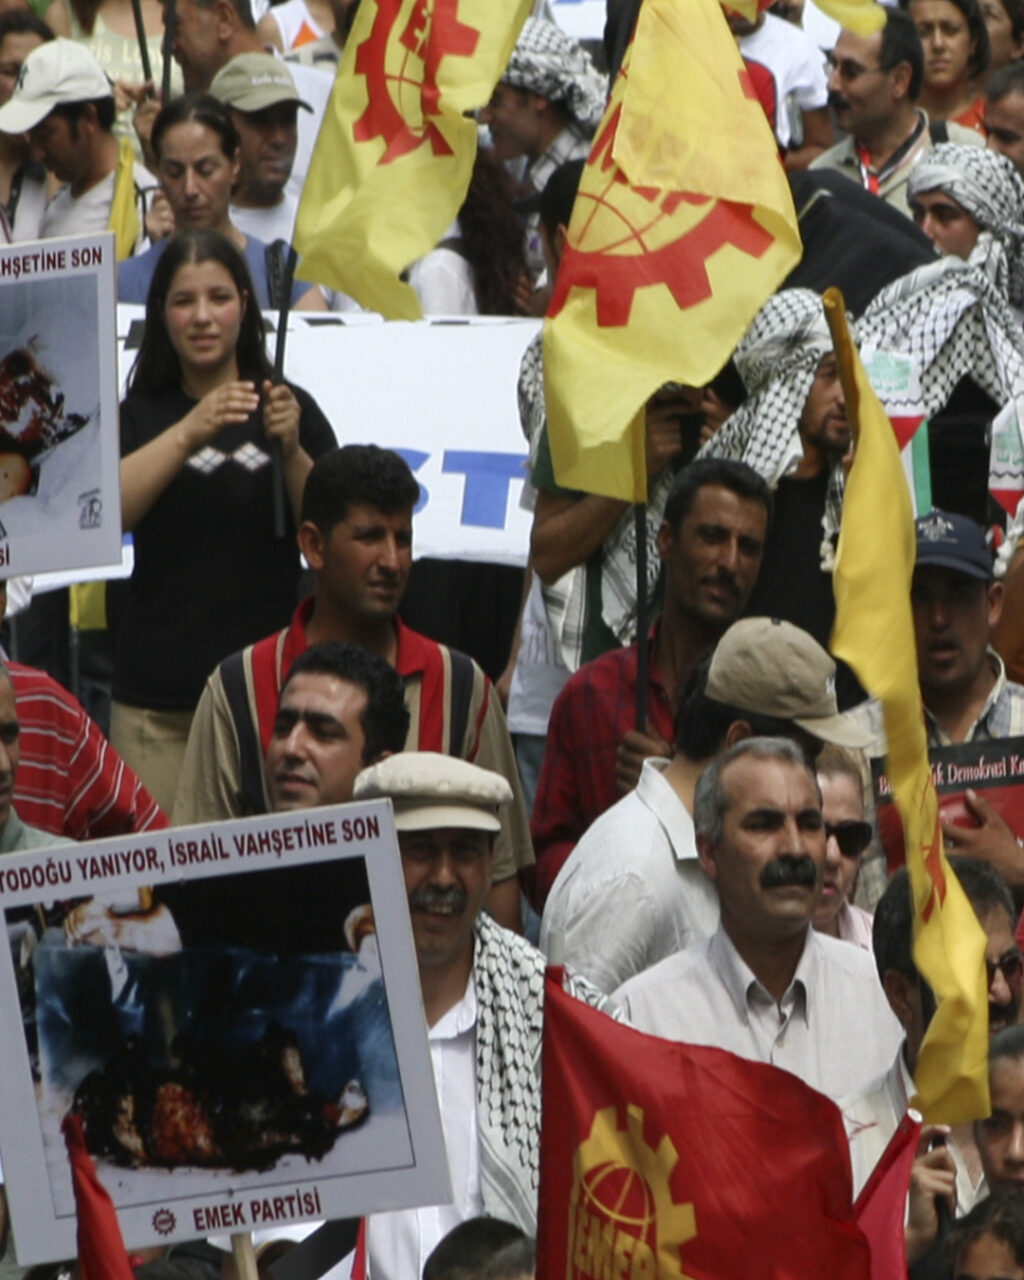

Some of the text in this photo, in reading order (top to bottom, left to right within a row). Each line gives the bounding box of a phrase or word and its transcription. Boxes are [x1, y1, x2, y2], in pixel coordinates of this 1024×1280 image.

[0, 245, 102, 280] HŞETİNE SON
[947, 756, 1007, 785] Demokrasi
[77, 846, 165, 880] YANIYOR,
[168, 832, 231, 866] İSRAİL
[233, 819, 338, 859] VAHŞETİNE
[342, 815, 381, 842] SON
[192, 1185, 322, 1232] EMEK PARTİSİ
